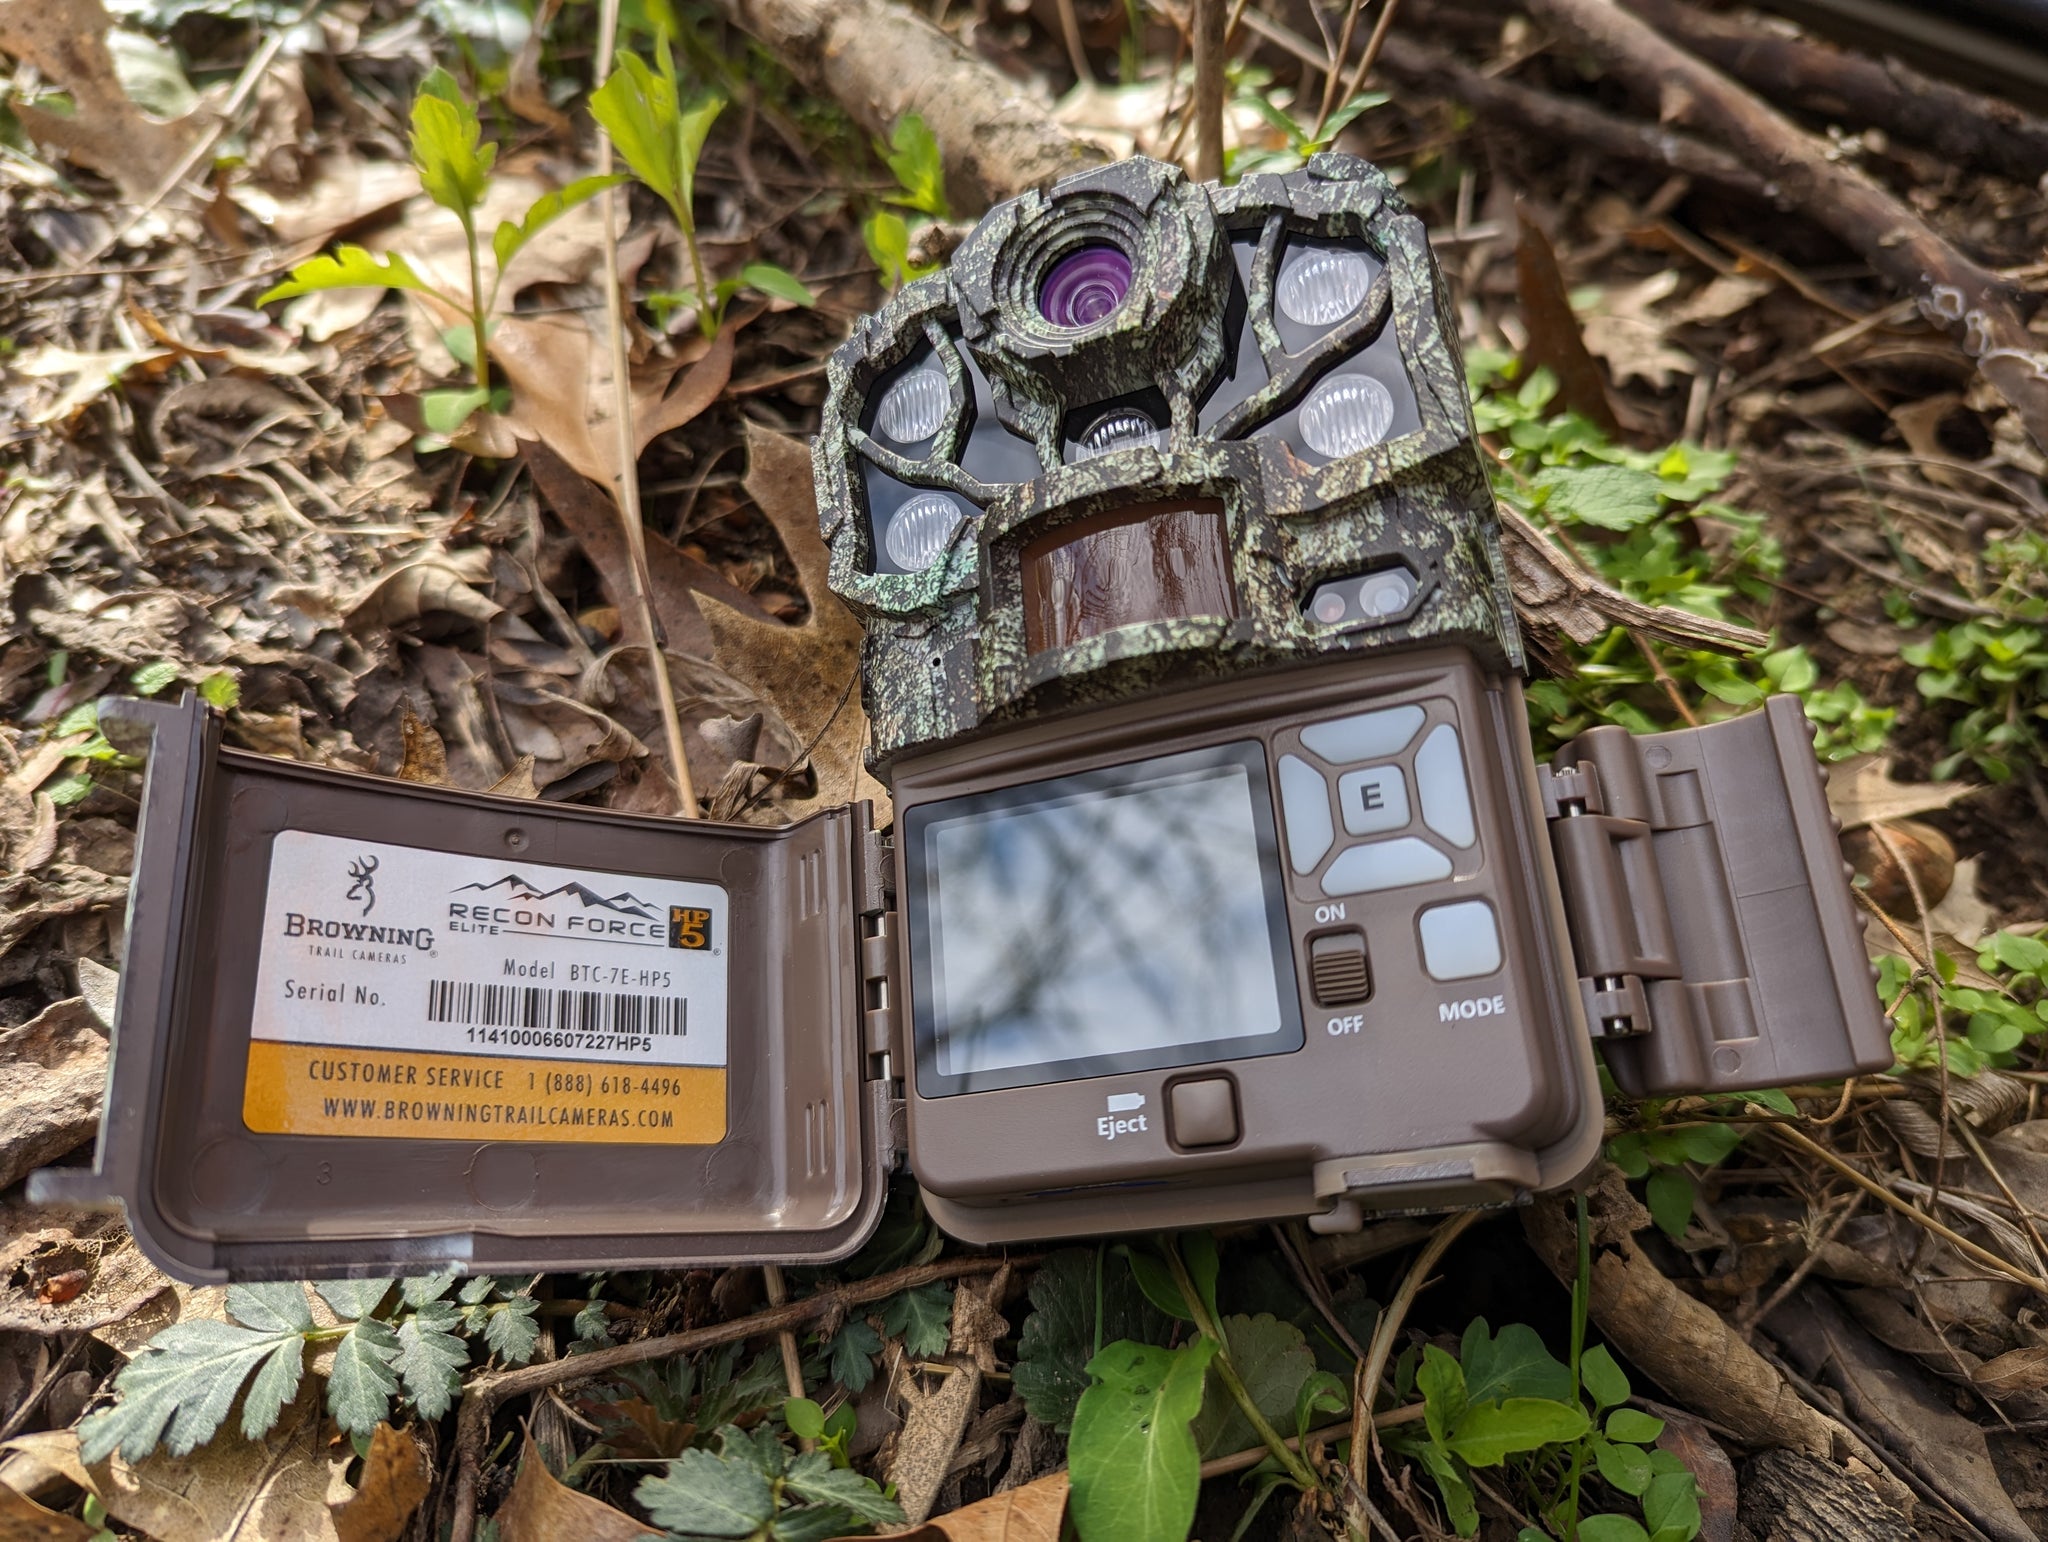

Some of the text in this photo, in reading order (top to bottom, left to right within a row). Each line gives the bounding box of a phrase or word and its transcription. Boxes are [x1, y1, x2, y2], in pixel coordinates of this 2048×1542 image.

[1360, 783, 1384, 812] E
[450, 902, 666, 938] RECON FORCE
[1315, 903, 1346, 924] ON
[284, 912, 435, 951] BROWNING
[449, 921, 500, 936] ELITE
[309, 945, 407, 964] TRAIL CAMERAS
[503, 958, 671, 988] Model BTC-7E-HP5
[285, 979, 386, 1006] Serial No.
[1438, 995, 1506, 1023] MODE
[1327, 1015, 1364, 1036] OFF
[467, 1027, 652, 1053] 11410006607227HP5
[309, 1060, 419, 1086] CUSTOMER
[427, 1066, 504, 1090] SERVICE
[546, 1072, 592, 1096] (888)
[601, 1074, 681, 1097] 618-4496
[323, 1097, 674, 1129] WWW.BROWNINGTRAILCAMERAS.COM
[1096, 1113, 1148, 1141] Eject
